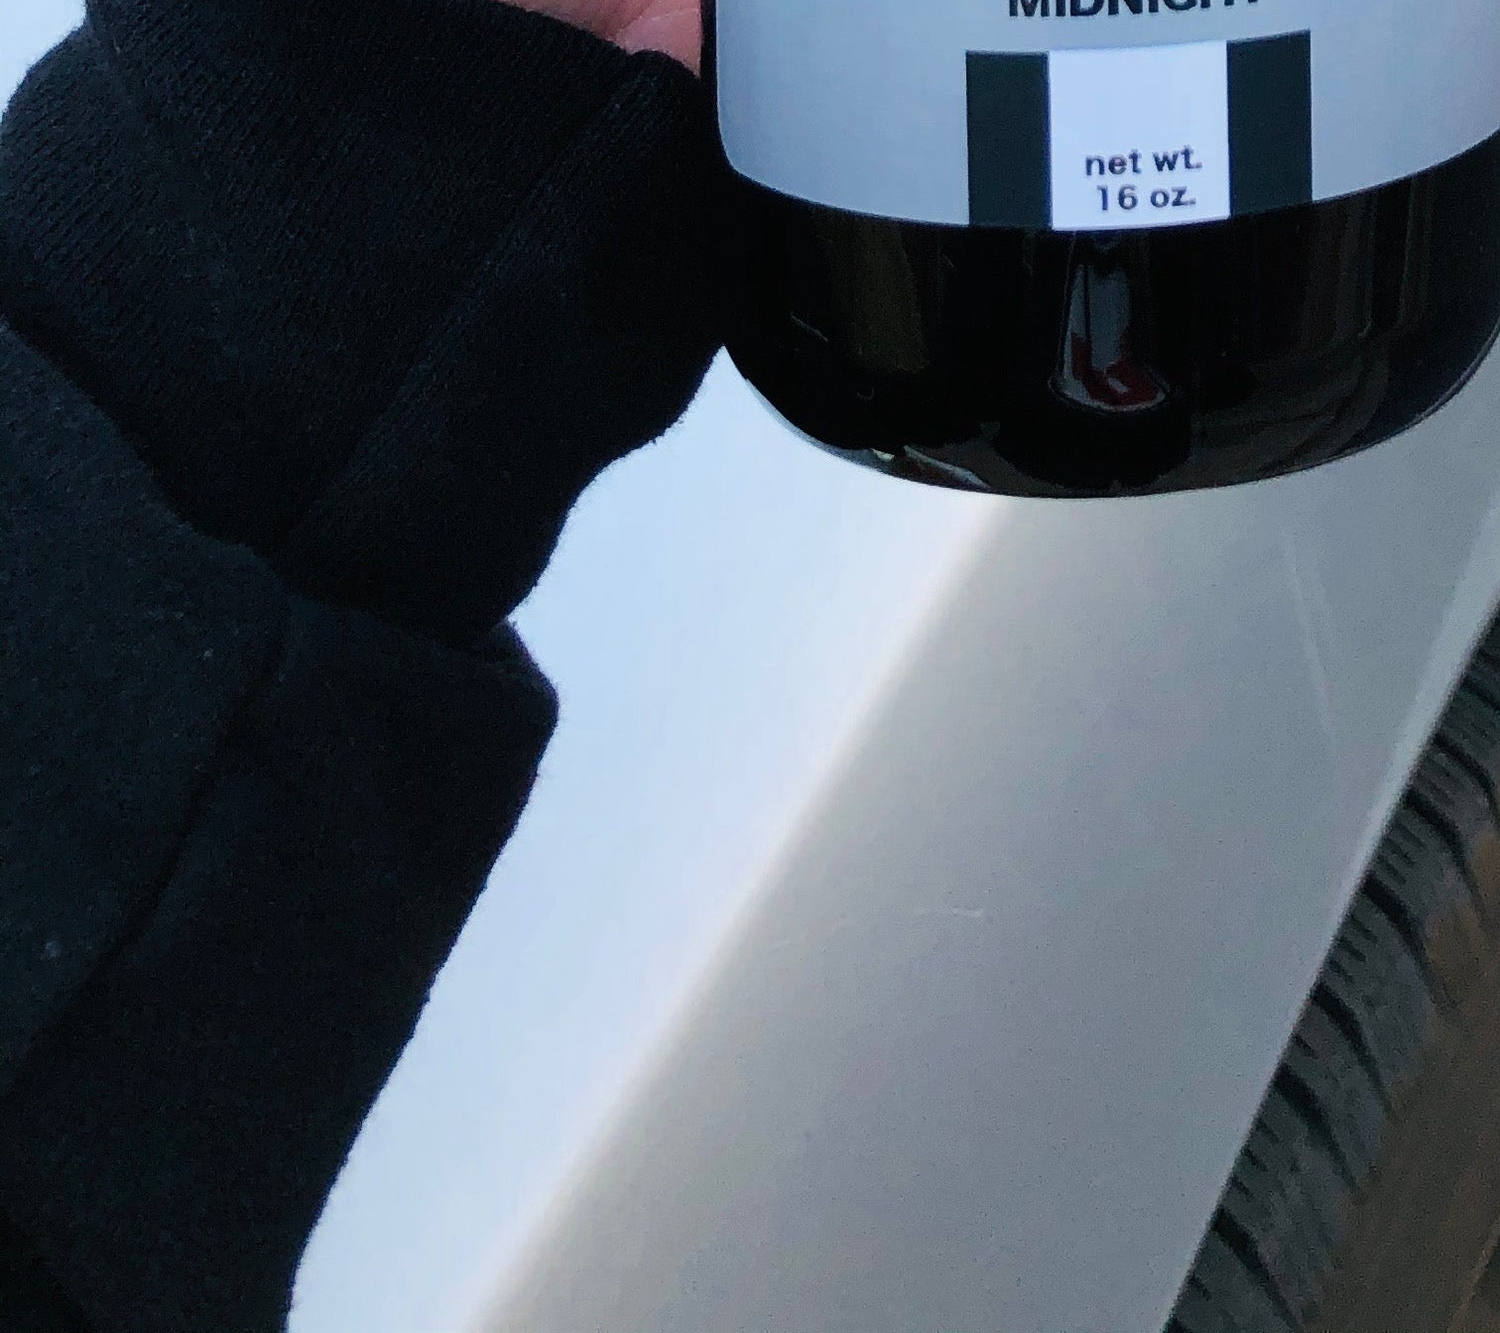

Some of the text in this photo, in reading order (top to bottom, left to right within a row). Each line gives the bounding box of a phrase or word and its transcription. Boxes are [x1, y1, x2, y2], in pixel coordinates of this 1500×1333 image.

[1085, 144, 1203, 177] net wt.
[1096, 184, 1197, 211] 16 oz.
